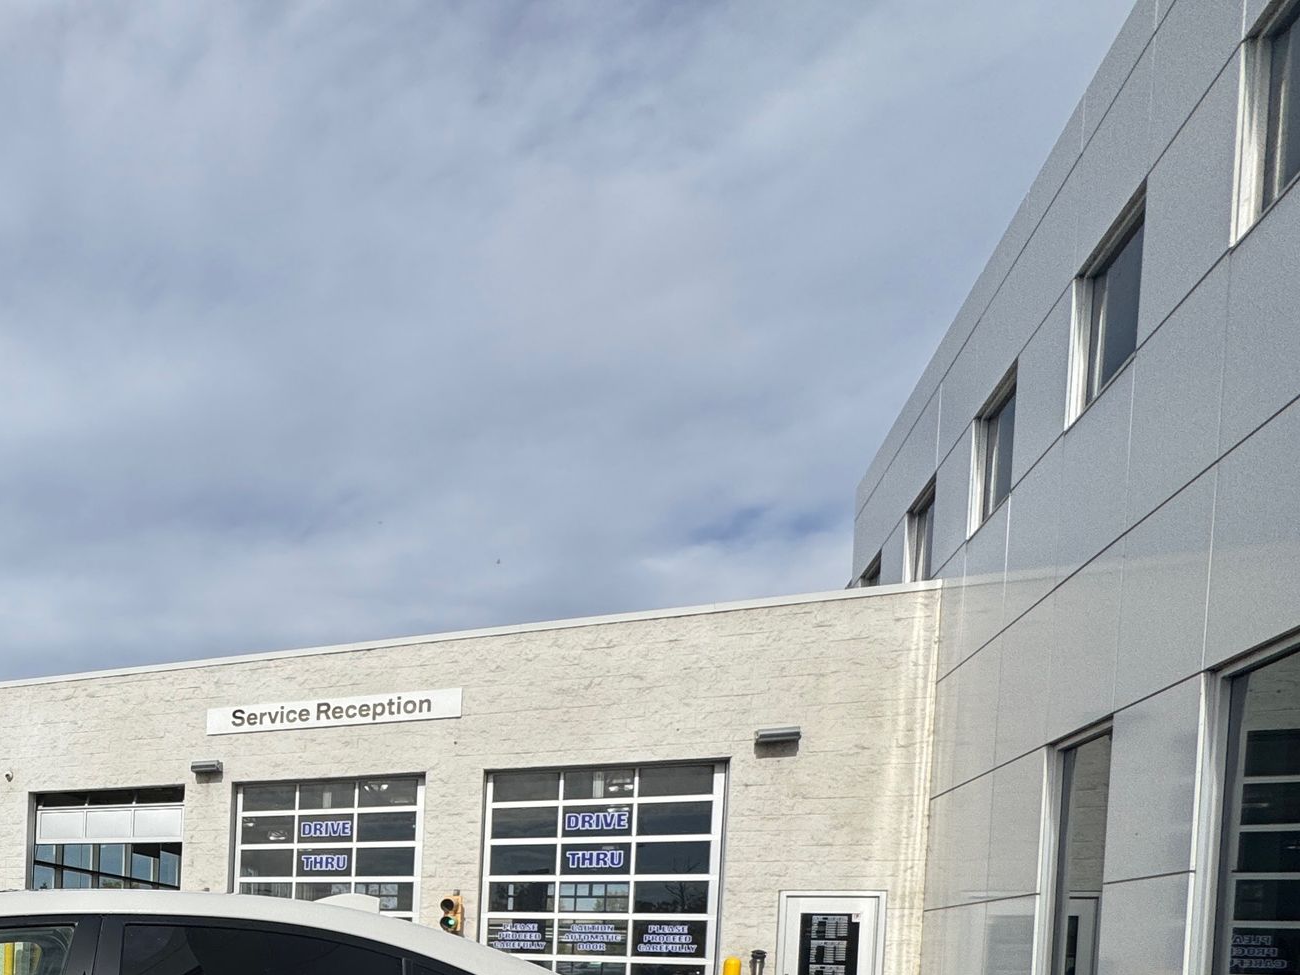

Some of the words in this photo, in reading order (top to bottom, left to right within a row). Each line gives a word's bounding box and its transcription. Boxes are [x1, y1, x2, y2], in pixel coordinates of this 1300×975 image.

[231, 705, 310, 727] Service
[316, 696, 432, 721] Reception
[565, 812, 628, 831] DRIVE
[301, 820, 351, 837] DRIVE
[301, 855, 348, 871] THRU
[567, 850, 624, 868] THRU
[503, 923, 538, 931] PLEASE
[571, 924, 615, 932] CAUTION
[648, 925, 688, 933] PLEASE
[498, 932, 541, 940] PROCEED
[564, 934, 621, 942] AUTOMATIC
[643, 934, 692, 943] PROCEED
[493, 941, 546, 950] CAREFULLY
[577, 943, 606, 951] DOOR
[638, 944, 697, 953] CAREFULLY
